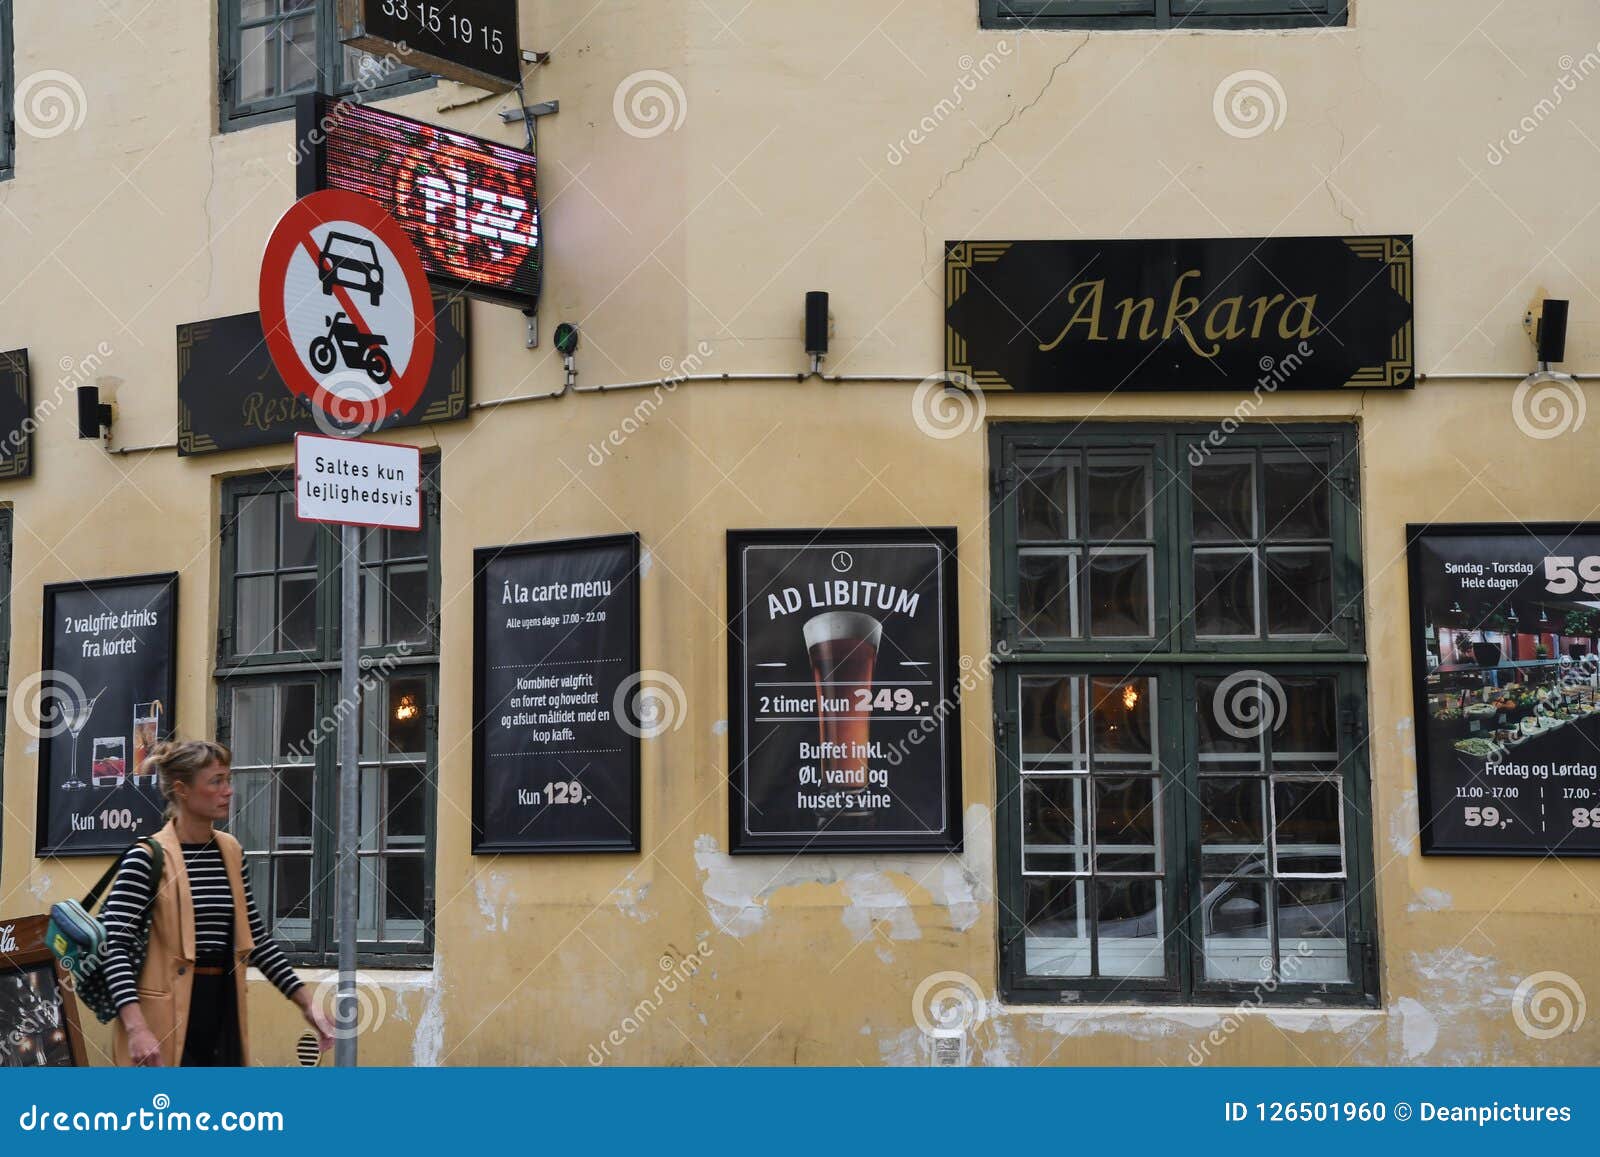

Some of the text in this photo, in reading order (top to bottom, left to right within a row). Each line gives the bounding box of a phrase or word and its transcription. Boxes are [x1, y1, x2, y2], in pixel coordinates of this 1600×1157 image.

[382, 0, 504, 55] 33 15 19 15
[1038, 269, 1320, 358] Ankara
[315, 456, 404, 481] Saltes kun
[306, 481, 412, 506] lejlighedsvis
[1444, 562, 1483, 576] Søndag
[1491, 562, 1534, 576] Torsdag
[502, 580, 611, 604] Á la carte menu
[1461, 577, 1518, 590] Hele dagen
[767, 580, 920, 620] AD LIBITUM
[64, 609, 158, 636] 2 valgfrie drinks
[506, 618, 521, 629] Alle
[522, 617, 541, 629] ugens
[542, 615, 560, 628] dage
[562, 613, 580, 625] 17.00
[586, 611, 606, 622] 22.00
[82, 637, 136, 658] fra kortet
[517, 673, 593, 690] Kombinér valgfrit
[510, 692, 599, 709] en forret og hovedret
[760, 687, 930, 715] 2 timer kun 249,-
[501, 708, 610, 729] og afslut måltidet med en
[533, 727, 576, 744] kop kaffe.
[799, 741, 887, 759] Buffet inkl.
[798, 766, 889, 788] Øl, vand og
[1485, 762, 1597, 780] Fredag og Lørdag
[518, 781, 592, 806] Kun 129,-
[797, 790, 891, 809] huset's vine
[1455, 786, 1483, 799] 11.00
[1491, 786, 1519, 799] 17.00
[1563, 787, 1590, 800] 17.00
[71, 808, 143, 832] Kun 100,-
[1464, 806, 1513, 830] 59,-
